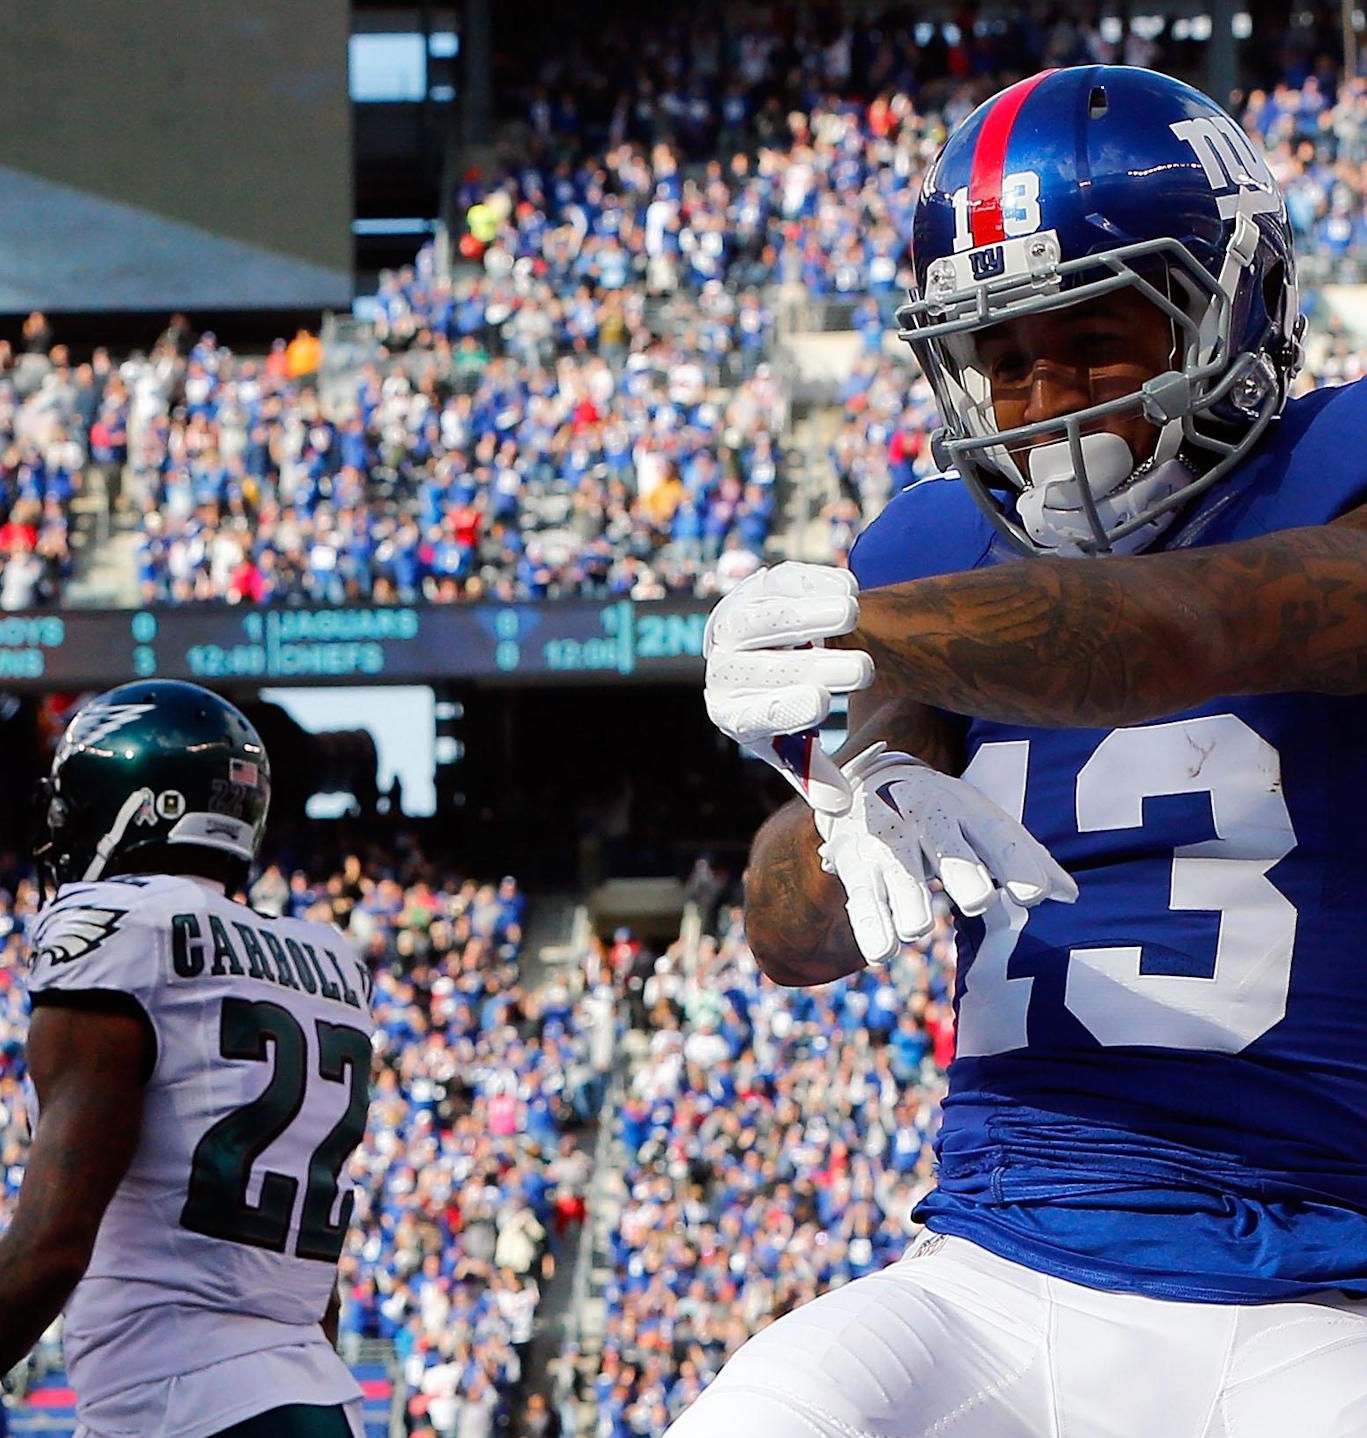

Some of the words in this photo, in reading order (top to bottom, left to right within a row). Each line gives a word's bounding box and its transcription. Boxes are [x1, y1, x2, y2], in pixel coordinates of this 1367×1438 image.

[280, 607, 419, 639] JAGUARS
[280, 641, 384, 674] CHIEFS
[956, 713, 1298, 1058] 13
[172, 913, 361, 1010] CARROLL
[179, 997, 375, 1263] 22
